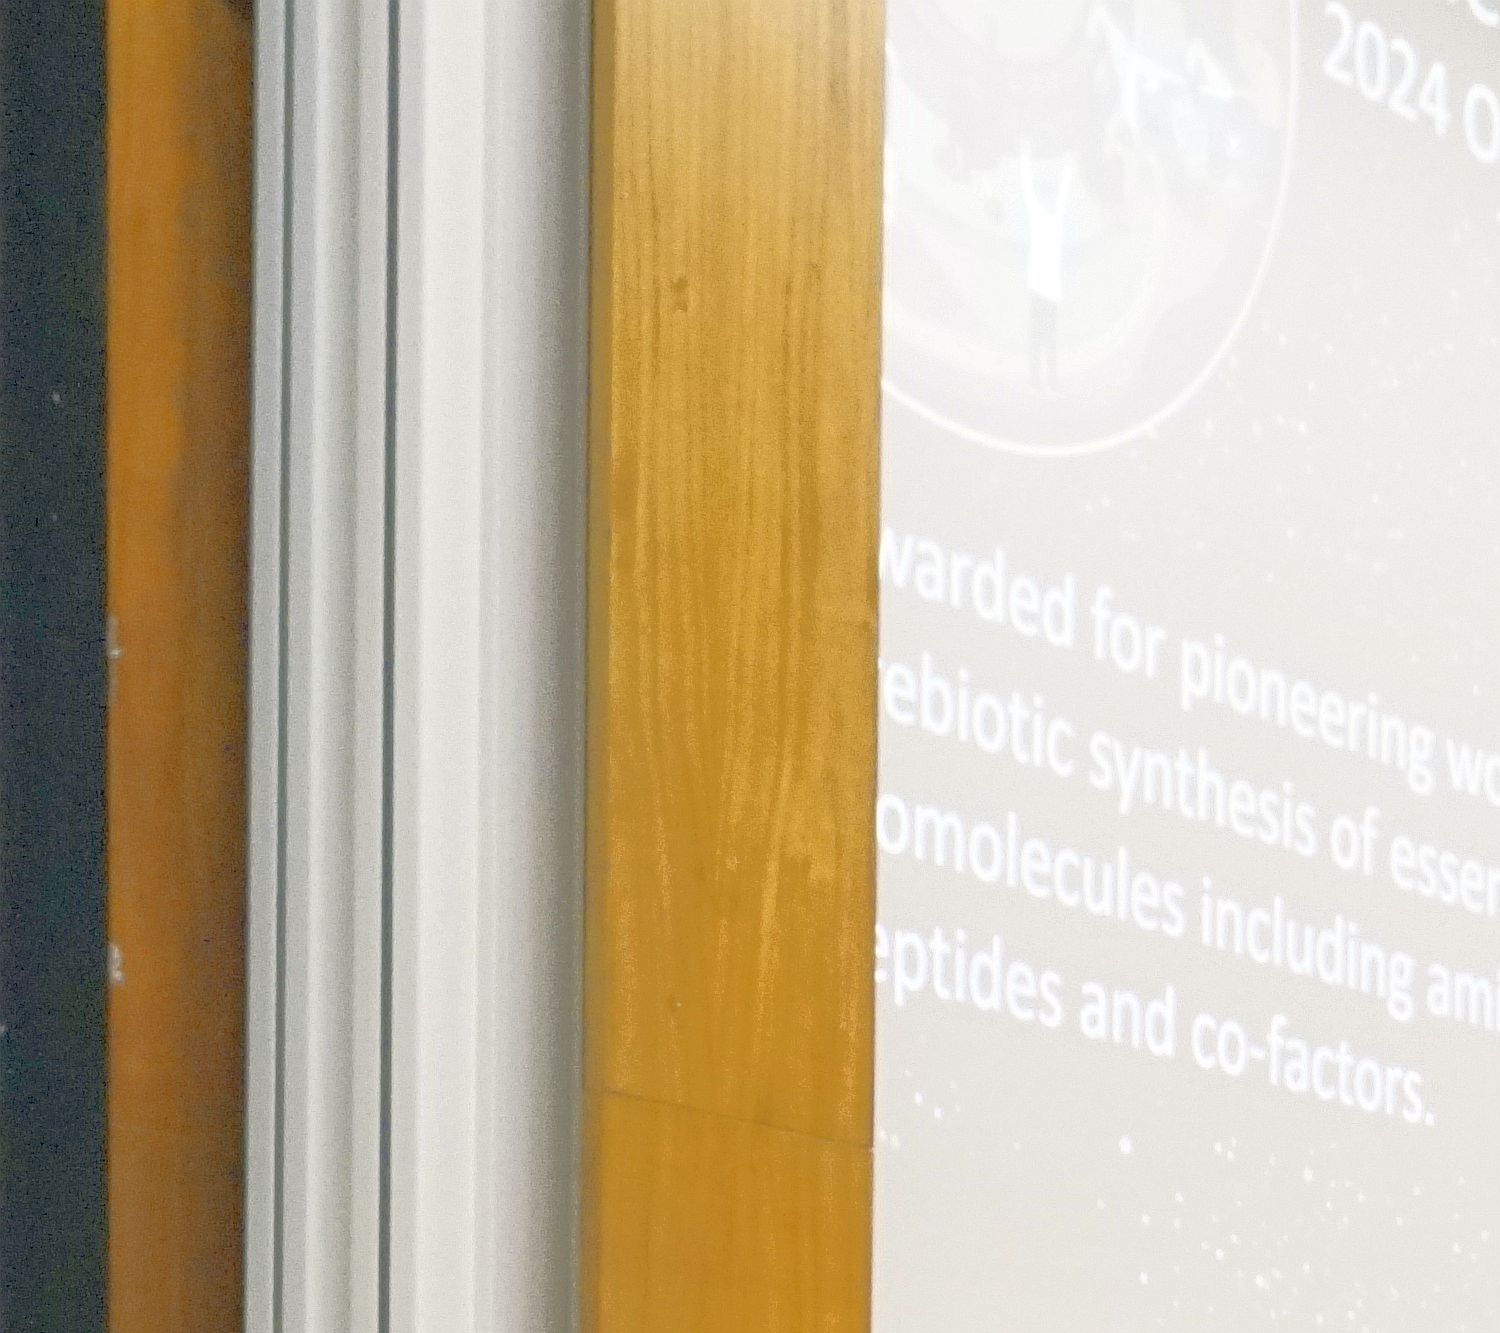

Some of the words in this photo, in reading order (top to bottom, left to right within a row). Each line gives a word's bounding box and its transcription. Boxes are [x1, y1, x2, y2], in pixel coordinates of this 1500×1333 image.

[1323, 2, 1452, 137] 2024
[877, 649, 1075, 778] ebiotic
[1089, 730, 1318, 857] synthesis
[1329, 804, 1381, 876] of
[1089, 583, 1167, 680] for
[1180, 631, 1437, 796] pioneering
[1199, 873, 1416, 1022] including
[1079, 980, 1176, 1058] and
[1190, 1012, 1436, 1127] co-factors.
